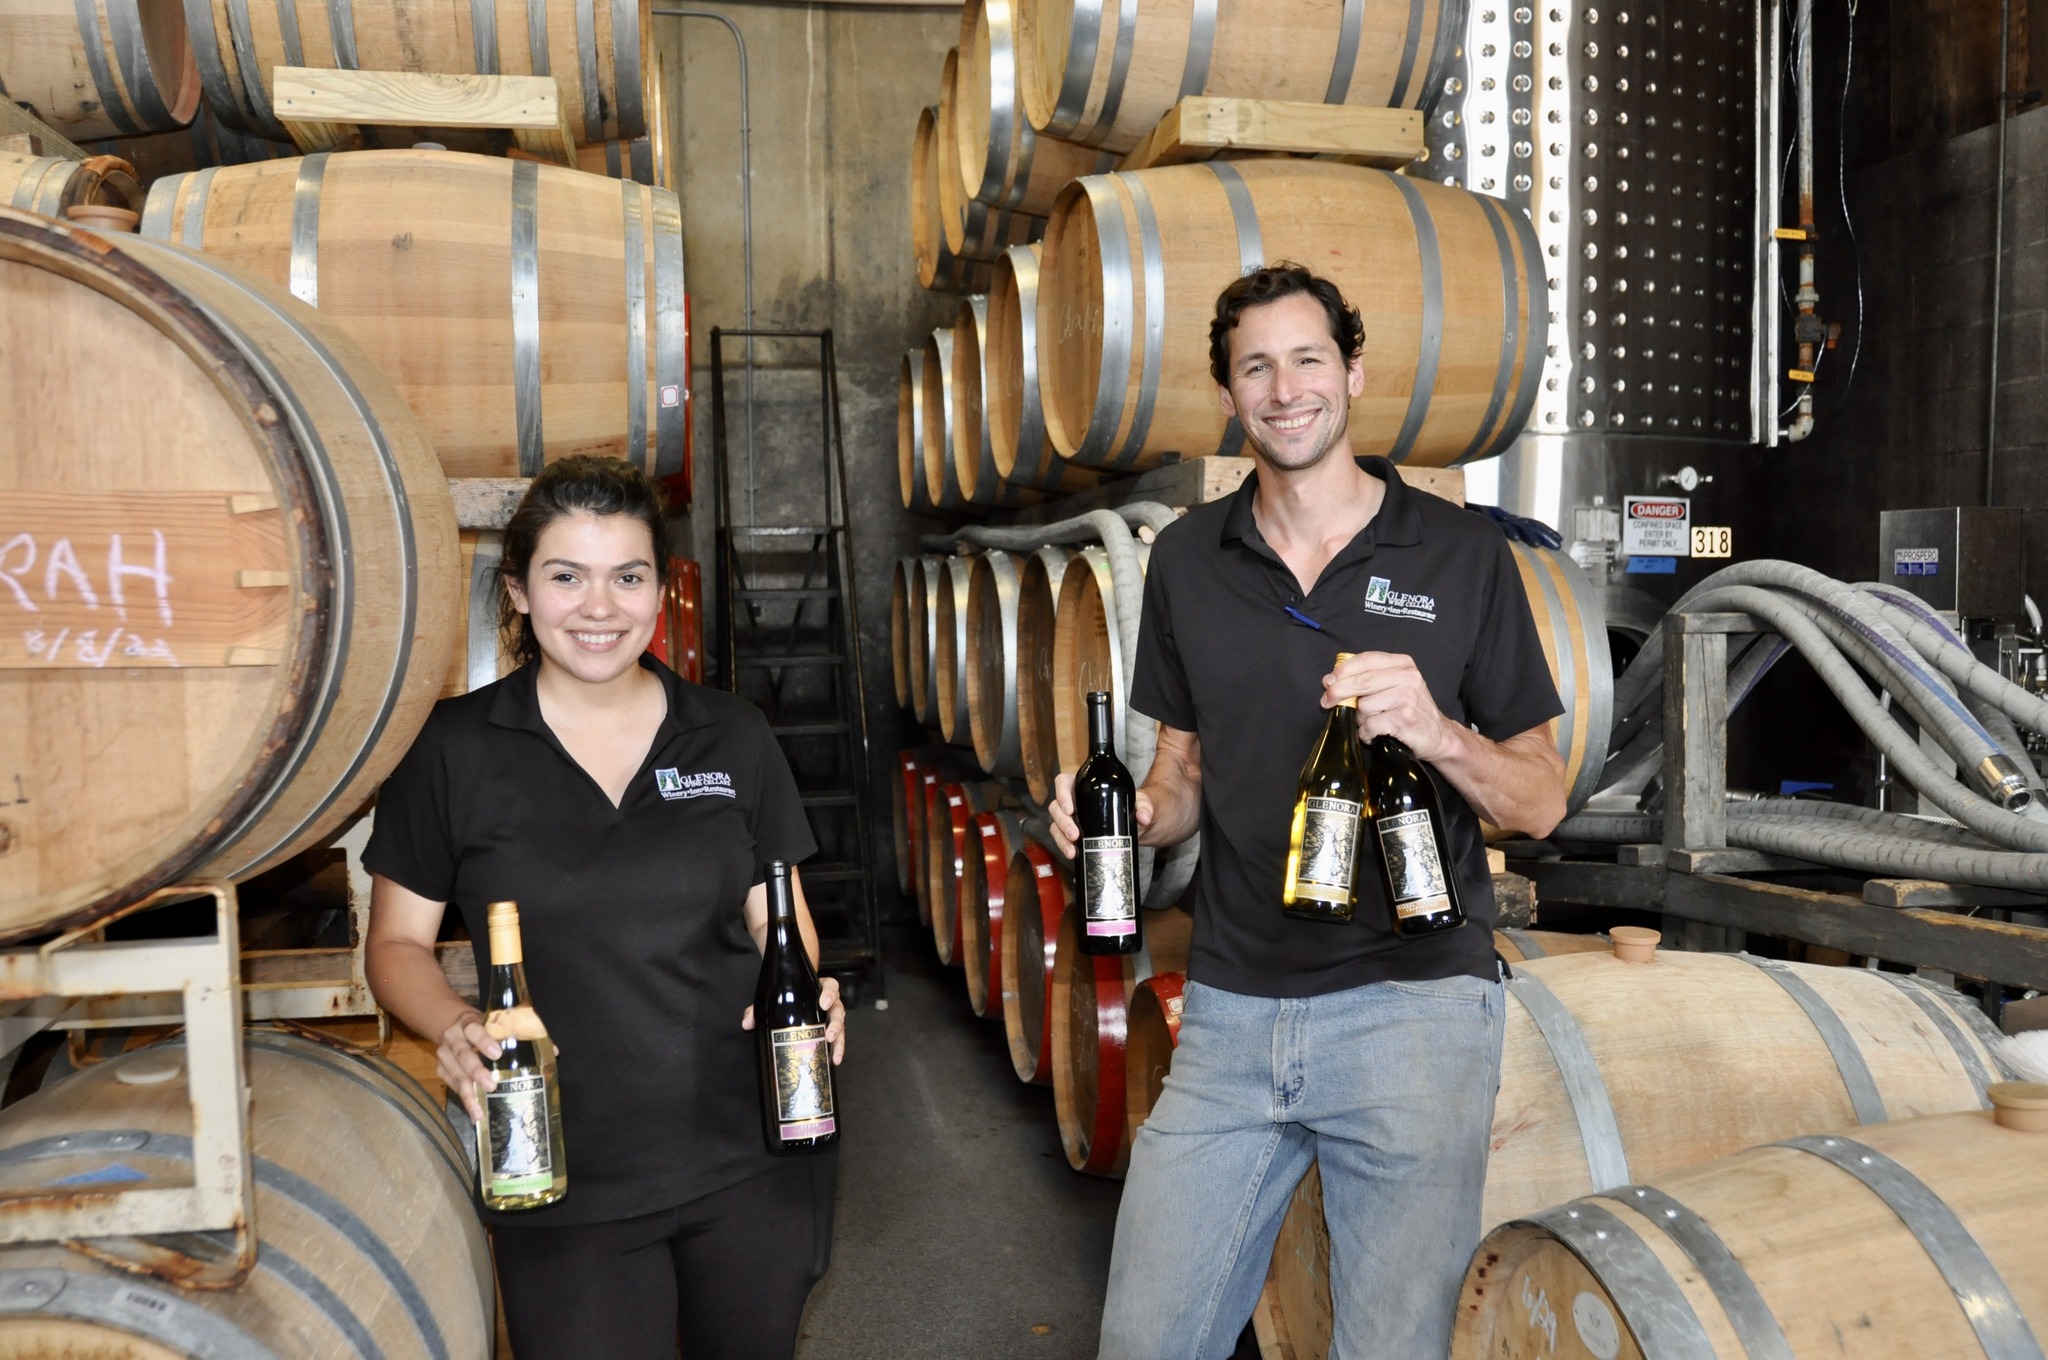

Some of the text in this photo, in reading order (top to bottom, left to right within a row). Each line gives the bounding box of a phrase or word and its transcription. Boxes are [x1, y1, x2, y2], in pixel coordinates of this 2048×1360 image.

[1637, 505, 1679, 516] DANGER
[1633, 521, 1682, 530] CONFINED SPACE
[1645, 530, 1673, 538] ENTER BY
[1639, 539, 1677, 548] PERMIT ONLY
[1695, 529, 1729, 554] 318
[1904, 551, 1936, 561] PROSPERO
[1387, 591, 1435, 607] GLENORA
[680, 772, 731, 784] GLENORA
[1308, 800, 1356, 814] GLENORA
[1380, 813, 1427, 829] GLENORA
[1085, 840, 1130, 849] GLENORA
[775, 1029, 825, 1042] GLENORA
